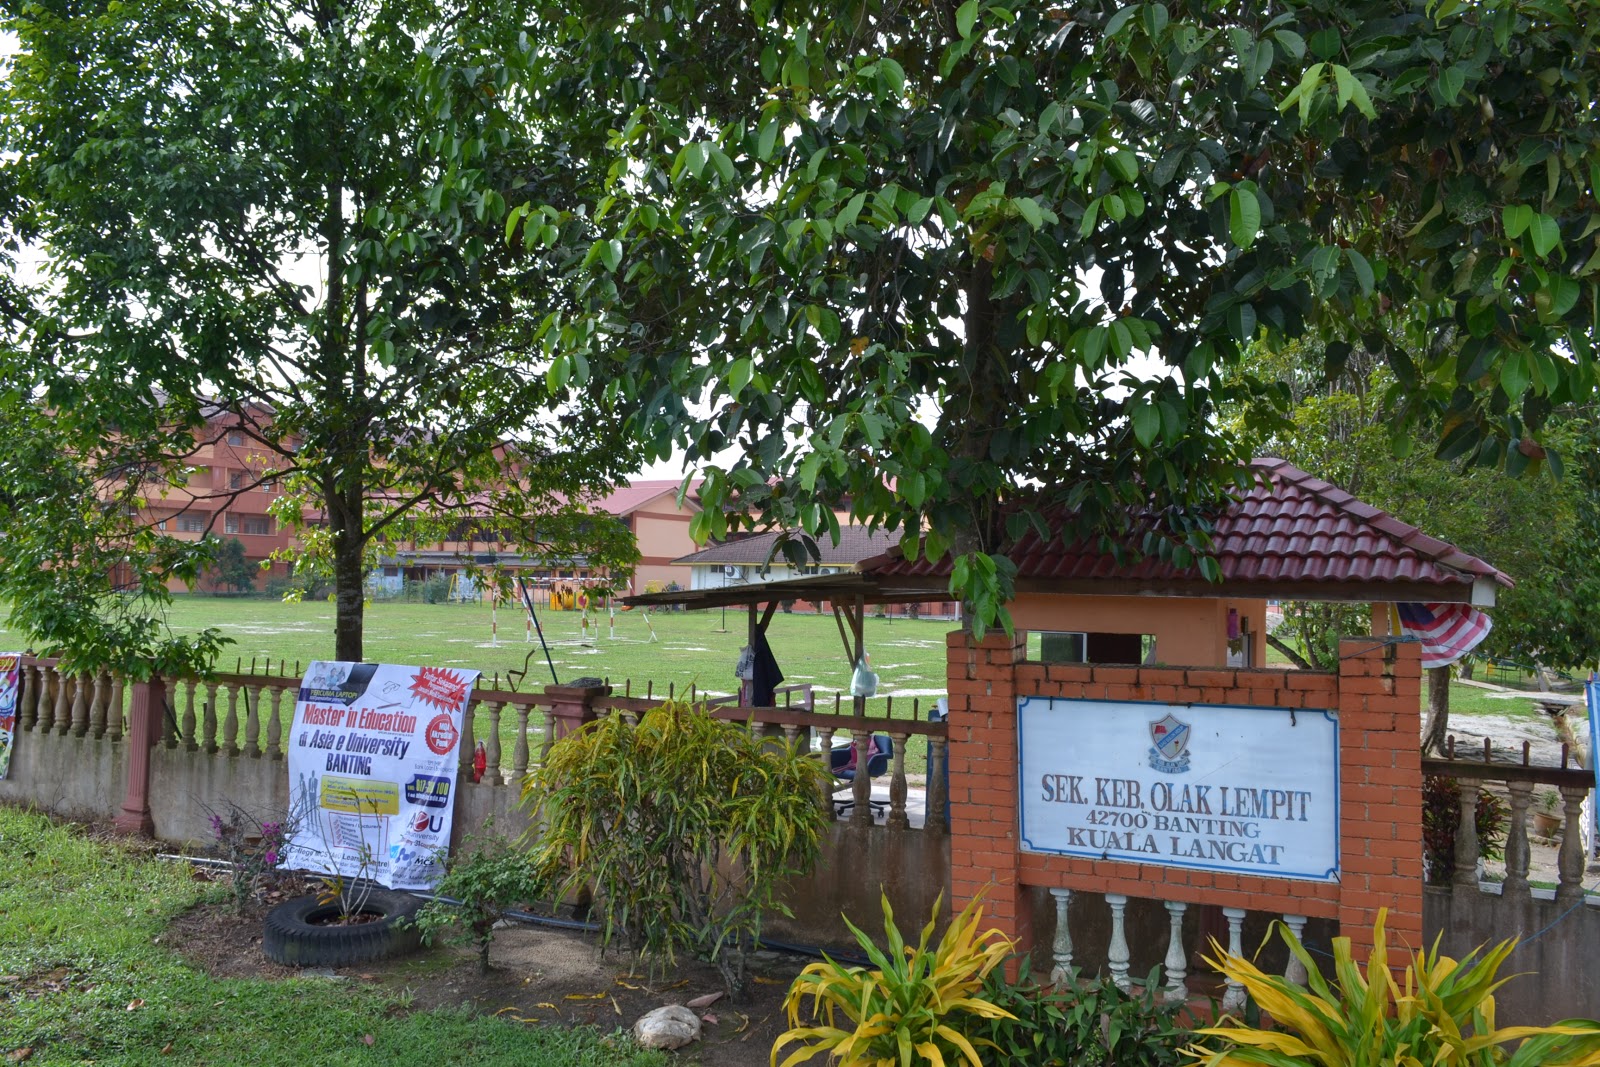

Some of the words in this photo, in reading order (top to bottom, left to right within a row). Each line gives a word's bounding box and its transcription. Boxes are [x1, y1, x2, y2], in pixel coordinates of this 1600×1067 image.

[310, 690, 334, 698] PERCUMA
[302, 703, 345, 728] Master
[346, 706, 357, 728] in
[358, 708, 417, 734] Education
[299, 731, 308, 748] di
[309, 729, 336, 750] Asia
[336, 736, 343, 751] e
[345, 733, 411, 760] University
[326, 752, 372, 776] BANTING
[1041, 773, 1089, 805] SEK.
[1094, 777, 1145, 810] KEB.
[1150, 781, 1213, 816] OLAK
[1220, 786, 1312, 822] LEMPIT
[1086, 809, 1148, 829] 42700
[1153, 815, 1262, 839] BANTING
[289, 847, 314, 857] College
[1067, 826, 1161, 854] KUALA
[1169, 837, 1285, 865] LANGAT
[414, 857, 434, 866] MCS
